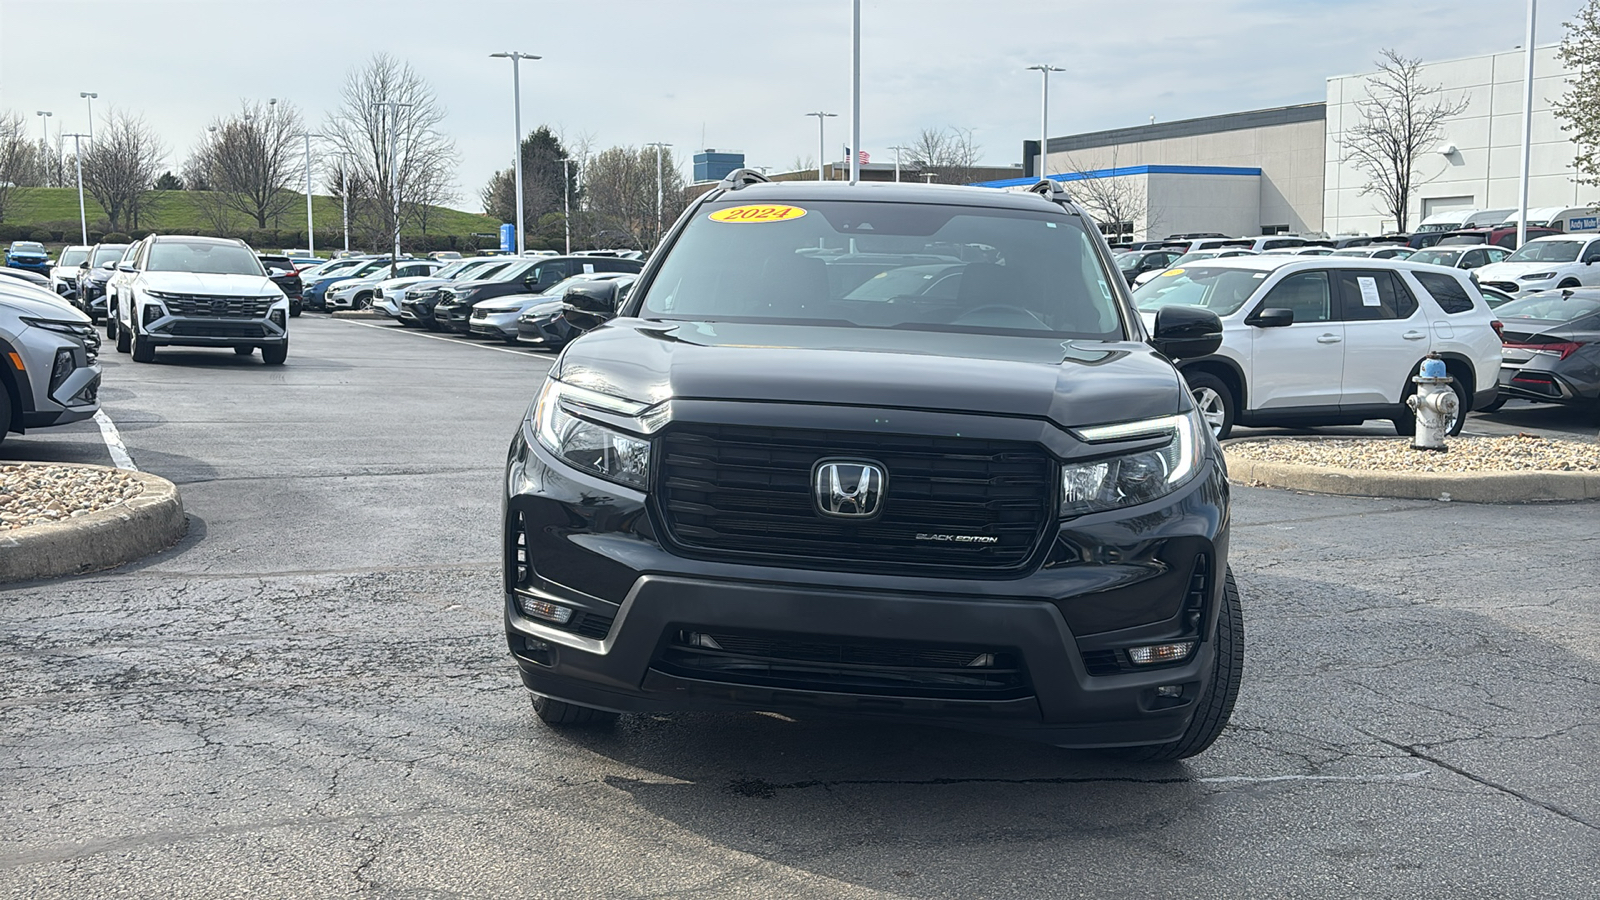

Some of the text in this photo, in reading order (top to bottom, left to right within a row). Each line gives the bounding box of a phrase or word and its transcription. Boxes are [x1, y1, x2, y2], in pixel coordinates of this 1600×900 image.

[724, 207, 792, 220] 2024
[1570, 220, 1583, 230] Andy
[915, 533, 998, 543] BLACK EDITION
